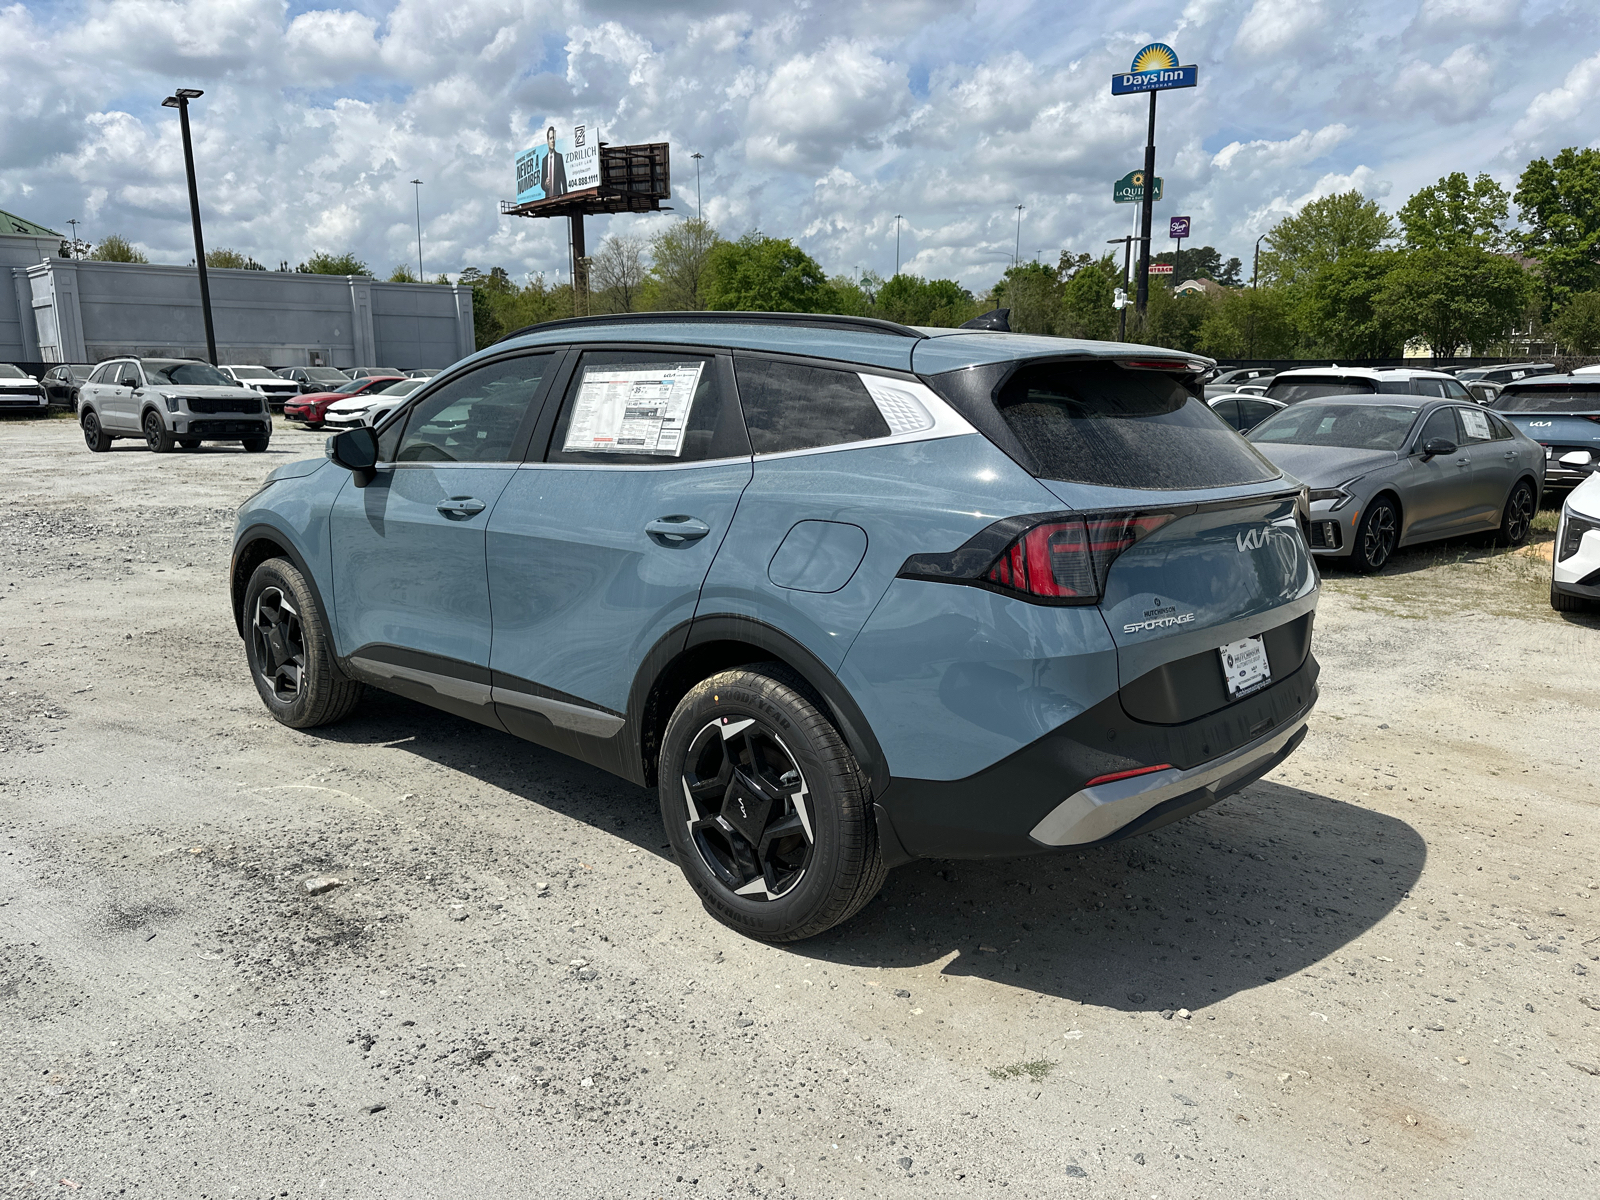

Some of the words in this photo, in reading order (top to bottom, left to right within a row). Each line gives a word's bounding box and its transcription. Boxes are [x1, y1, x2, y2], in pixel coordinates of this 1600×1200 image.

[1124, 74, 1158, 86] Days
[1160, 71, 1183, 81] Inn
[565, 146, 597, 163] ZDRILICH
[517, 158, 533, 181] NEVER
[535, 154, 540, 171] A
[518, 170, 540, 195] NUMBER
[568, 174, 599, 188] 404.888.1111
[1123, 188, 1159, 197] QUIA
[1236, 526, 1270, 553] KIA
[1144, 606, 1176, 617] HUTCHINSON
[1123, 612, 1196, 634] SPORTAGE
[717, 690, 791, 731] GOODYEAR
[695, 880, 765, 929] ASSURANCE
